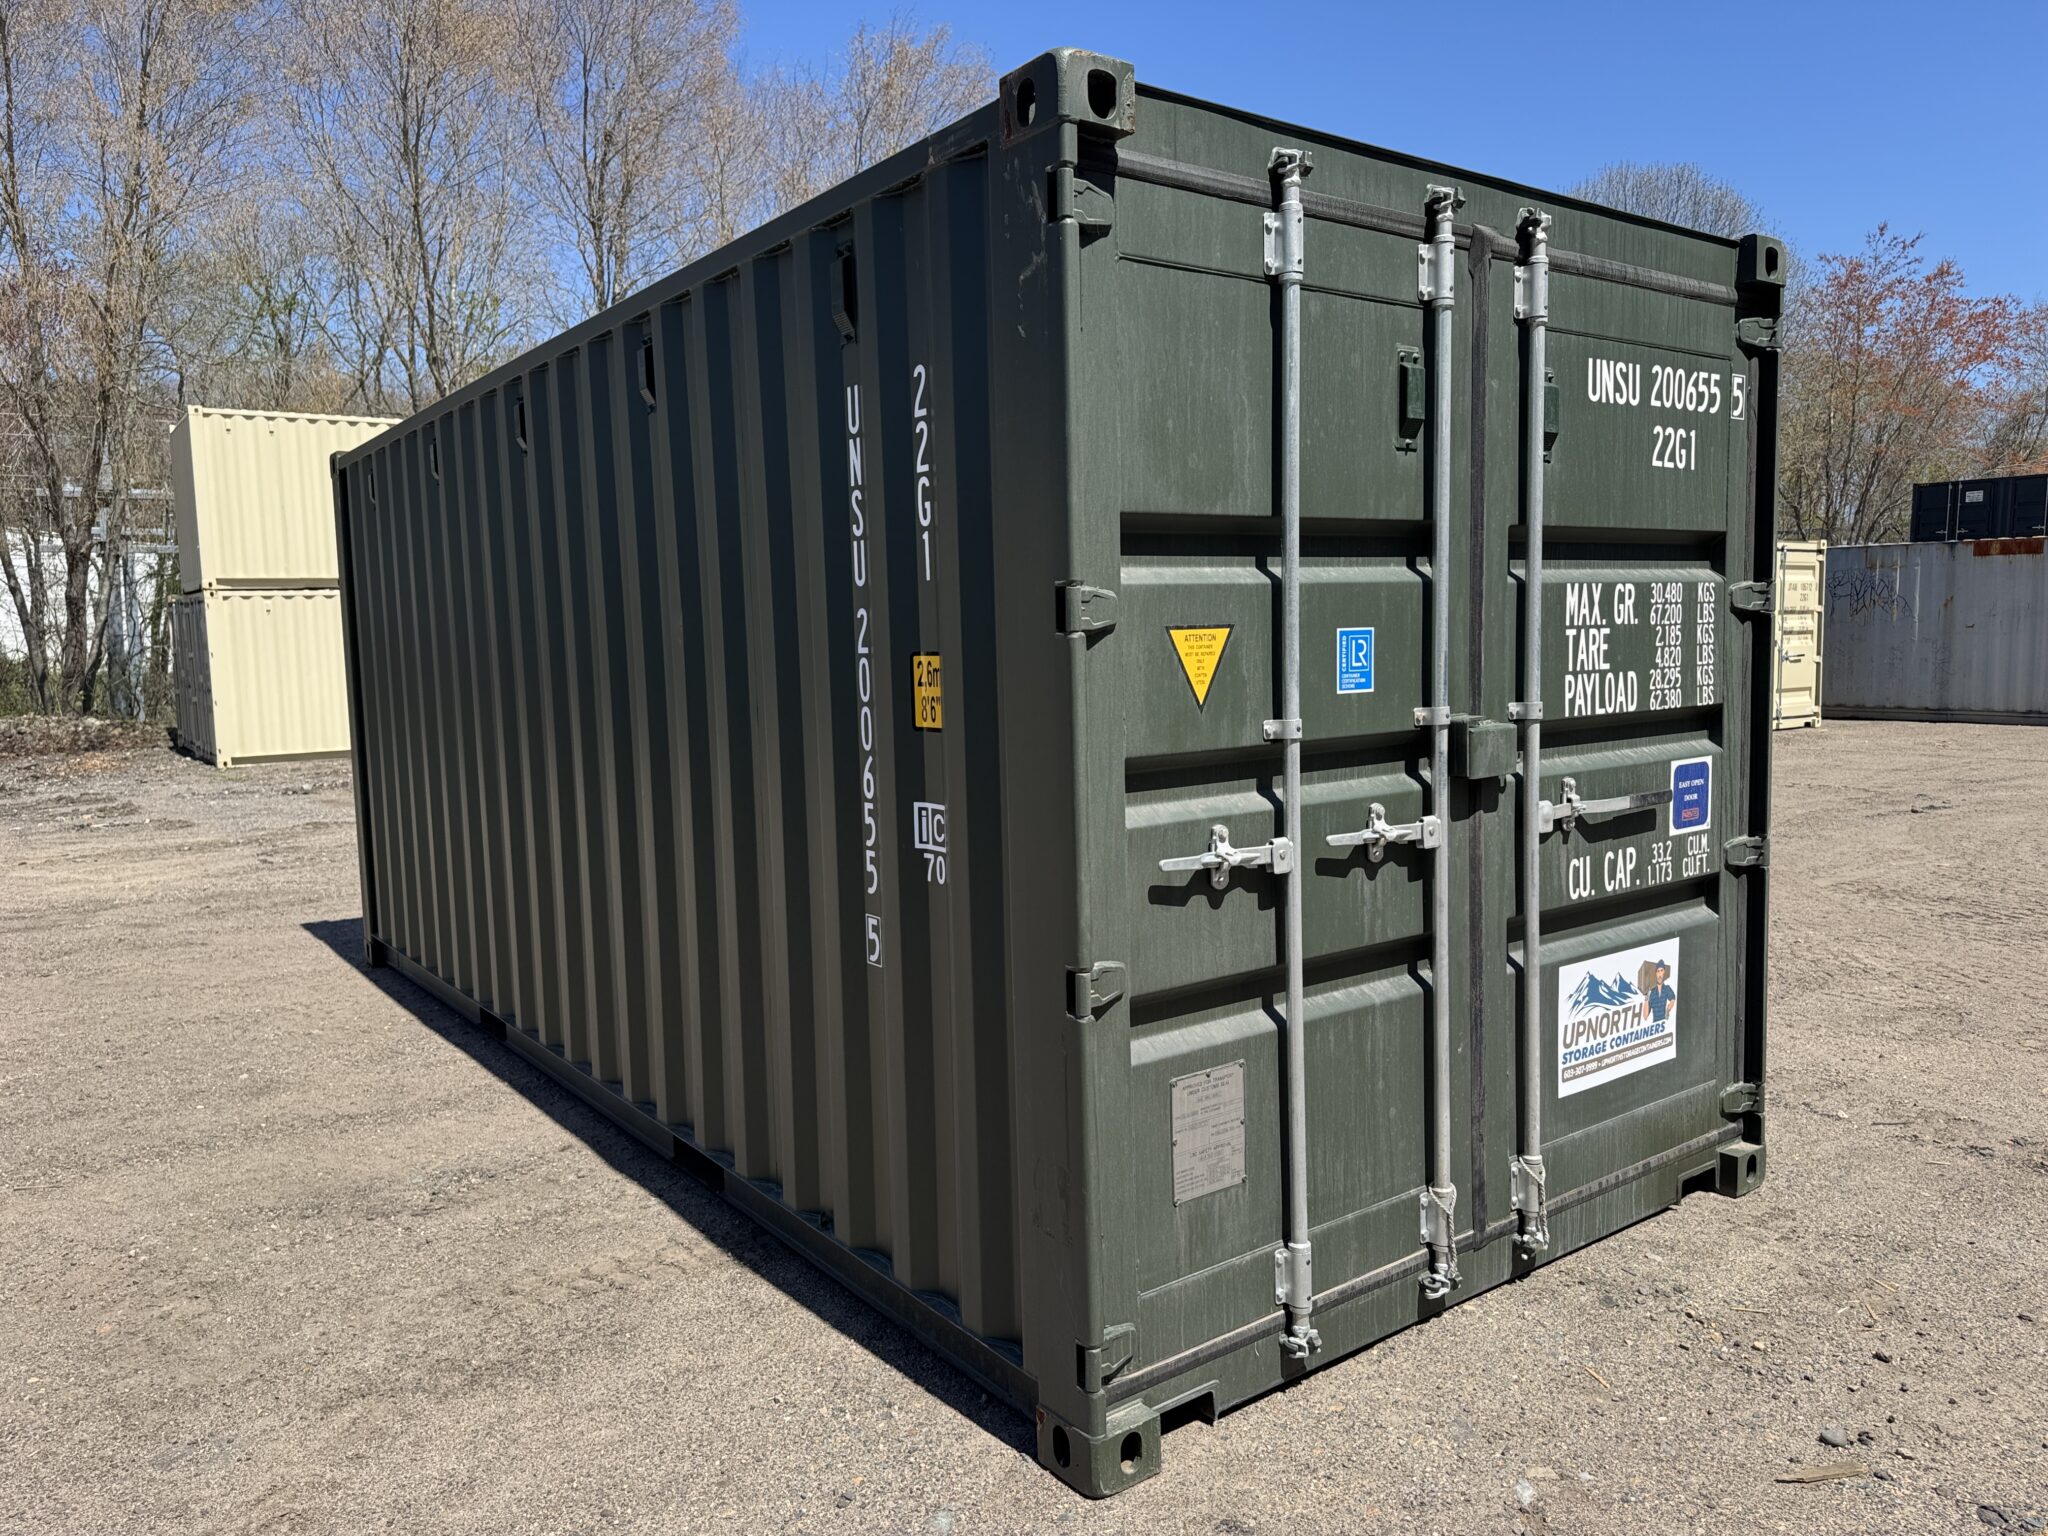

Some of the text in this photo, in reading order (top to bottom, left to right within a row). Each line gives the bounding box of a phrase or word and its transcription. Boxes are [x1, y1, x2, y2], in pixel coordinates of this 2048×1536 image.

[1587, 357, 1744, 418] UNSU 200655 5
[1652, 425, 1696, 470] 22G1
[913, 364, 931, 581] 22G1
[1565, 582, 1607, 626] MAX.
[1613, 582, 1639, 625] GR.
[1697, 582, 1715, 602] KGS
[1697, 603, 1715, 624] LBS
[1184, 633, 1217, 643] ATTENTION
[1351, 639, 1368, 667] LR
[1565, 628, 1610, 672] TARE
[1696, 624, 1714, 644] KGS
[1696, 645, 1714, 665] LBS
[847, 384, 880, 964] UNSU 200655 5
[1564, 671, 1638, 717] PAYLOAD
[1696, 665, 1714, 686] KGS
[1696, 686, 1714, 706] LBS
[1683, 793, 1698, 802] DOOR
[923, 852, 946, 885] 70
[1569, 856, 1595, 900] CU.
[1604, 847, 1640, 892] CAP.
[1652, 840, 1673, 863] 33.2
[1561, 1021, 1666, 1065] STORAGE CONTAINERS
[1562, 1002, 1643, 1049] UPNORTH
